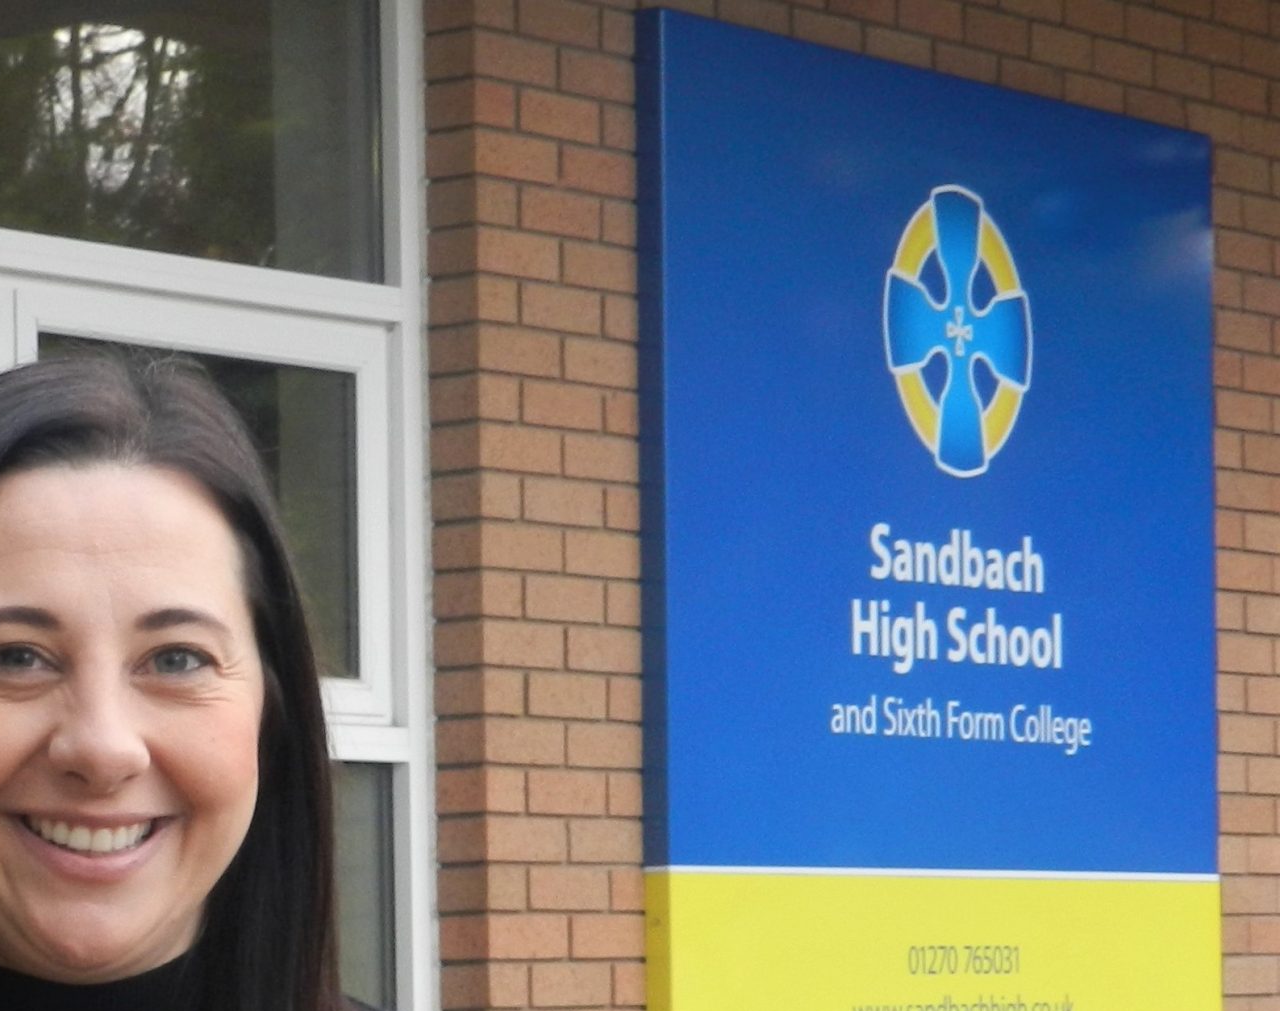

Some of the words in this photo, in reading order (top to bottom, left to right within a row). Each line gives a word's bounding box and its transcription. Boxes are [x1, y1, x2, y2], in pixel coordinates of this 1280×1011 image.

[870, 522, 1045, 594] Sandbach
[851, 598, 939, 674] High
[946, 606, 1063, 670] School
[830, 694, 877, 735] and
[882, 696, 941, 738] Sixth
[946, 700, 1005, 741] Form
[1010, 704, 1092, 756] College
[907, 945, 958, 975] 01270
[963, 945, 1020, 975] 765031
